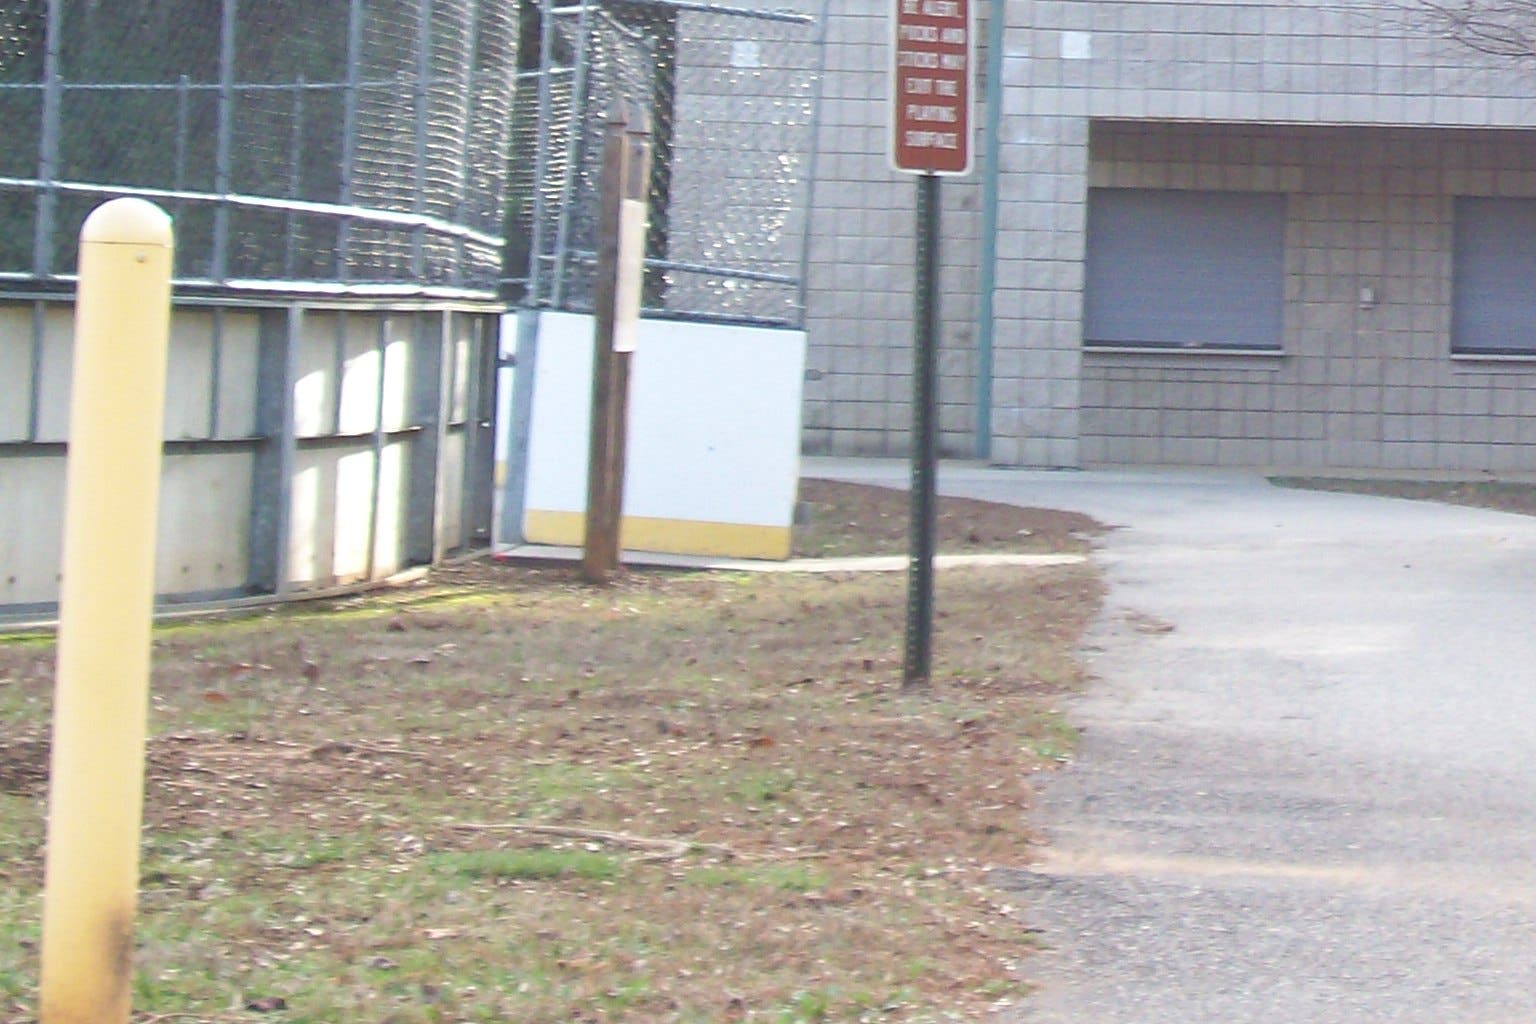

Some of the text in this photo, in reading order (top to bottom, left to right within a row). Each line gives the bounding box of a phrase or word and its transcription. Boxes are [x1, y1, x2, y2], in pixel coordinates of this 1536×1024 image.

[935, 80, 958, 96] THE
[905, 104, 957, 123] PLAYING
[905, 130, 958, 149] SURFACE
